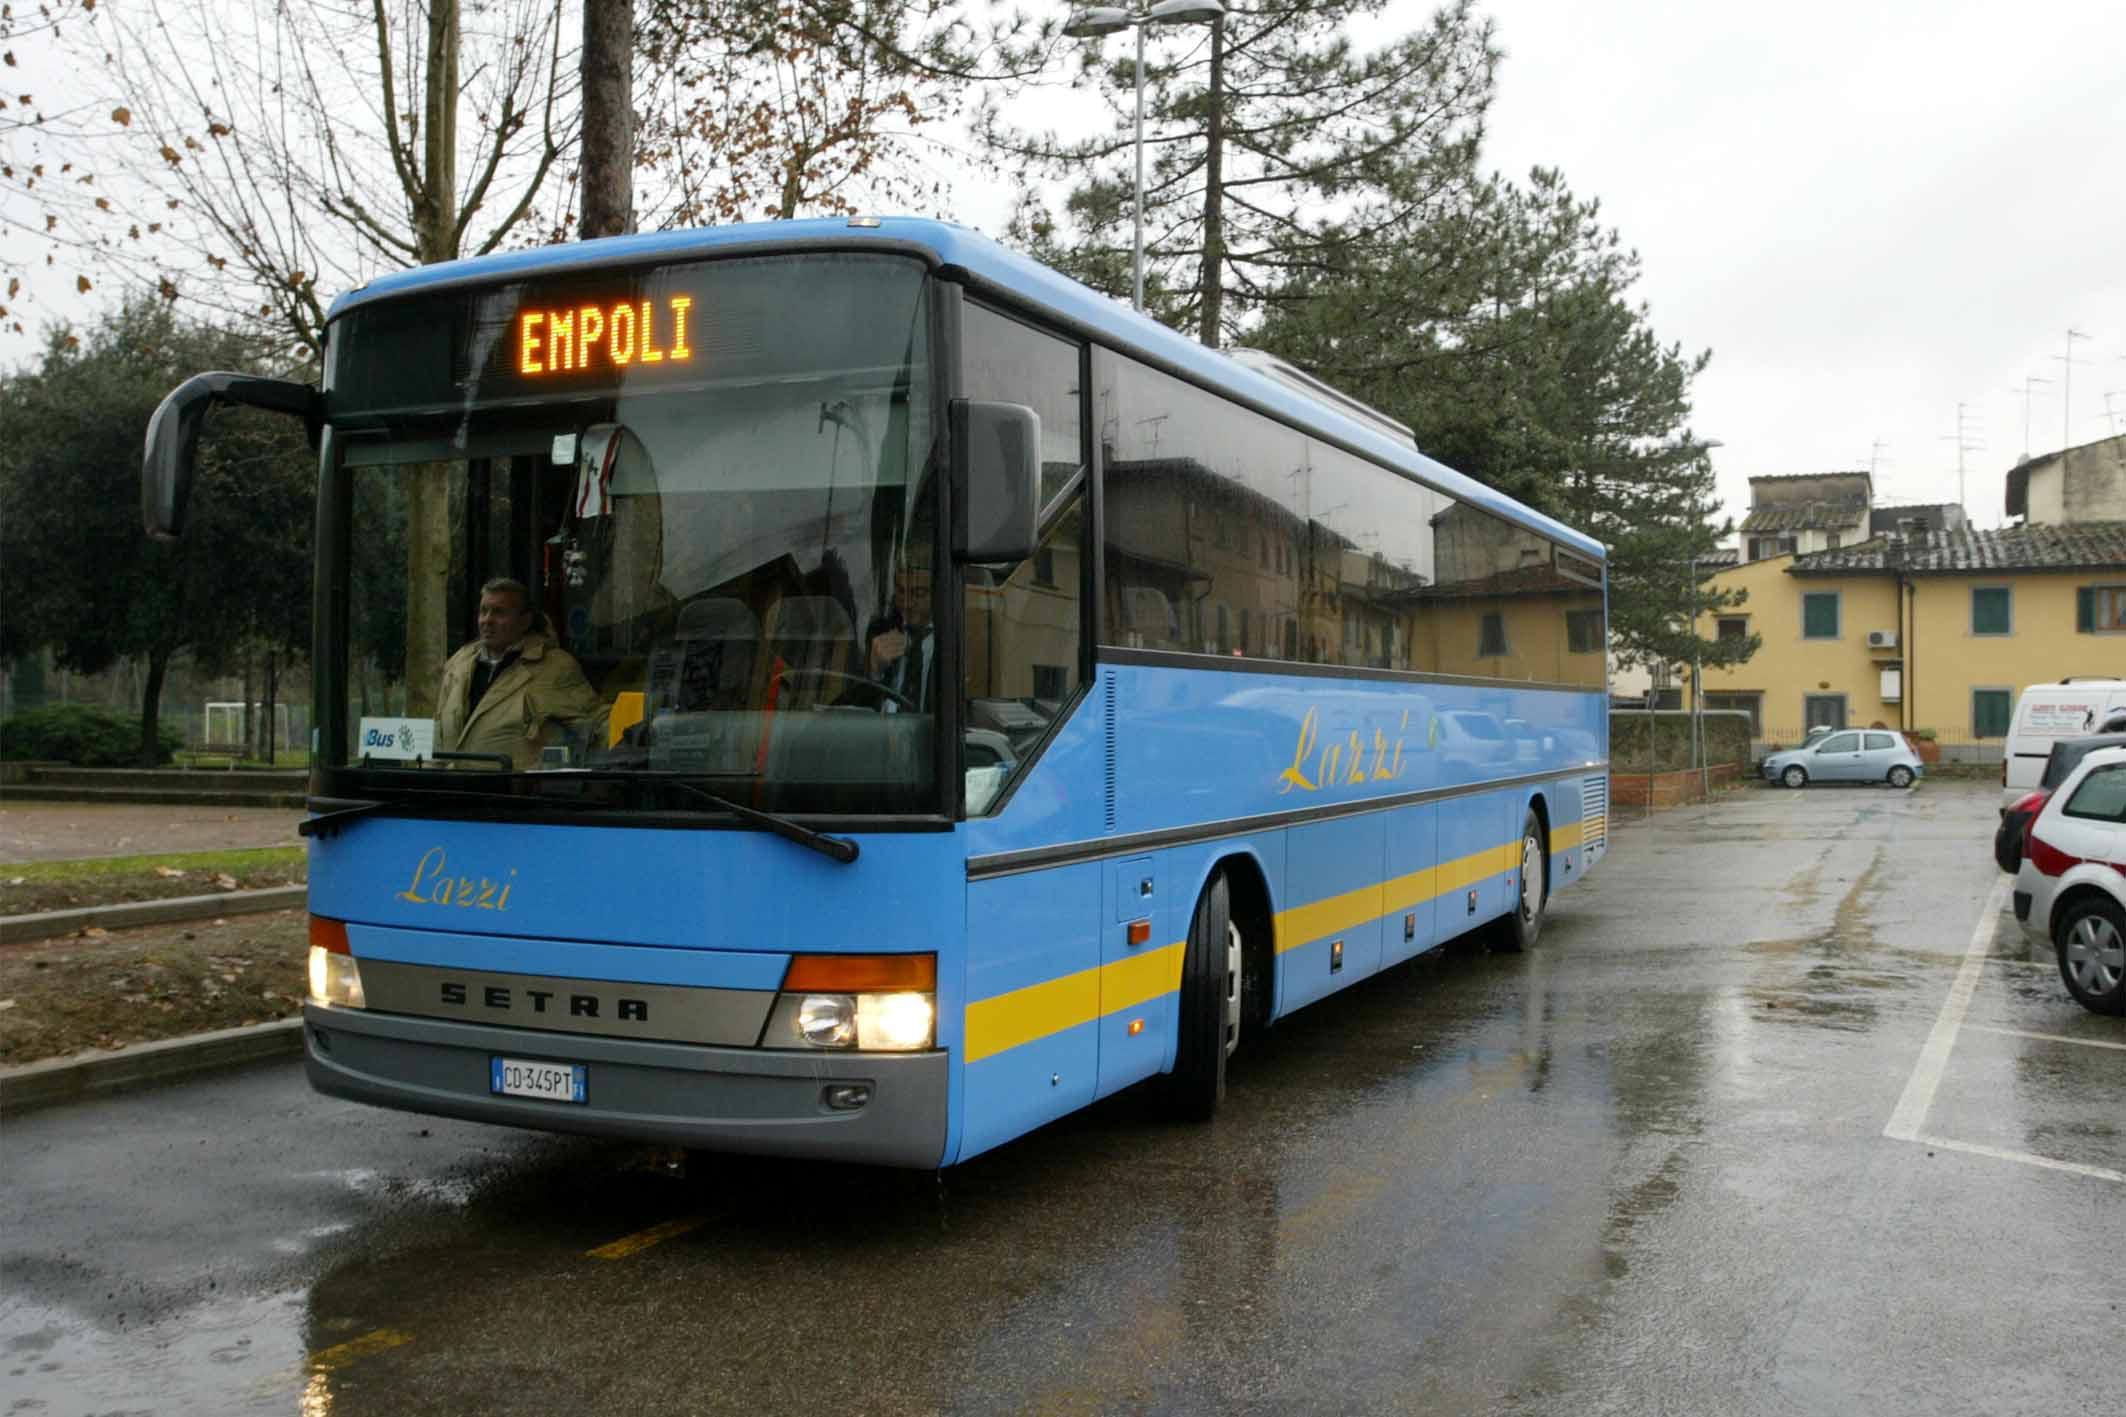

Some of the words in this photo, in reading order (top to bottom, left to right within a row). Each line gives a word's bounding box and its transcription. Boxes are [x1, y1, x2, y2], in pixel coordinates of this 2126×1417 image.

[521, 297, 692, 373] EMPOLI
[366, 729, 395, 747] Bus
[1278, 703, 1410, 795] Lazzi
[395, 847, 518, 911] Lazzi
[441, 982, 648, 1021] SETRA
